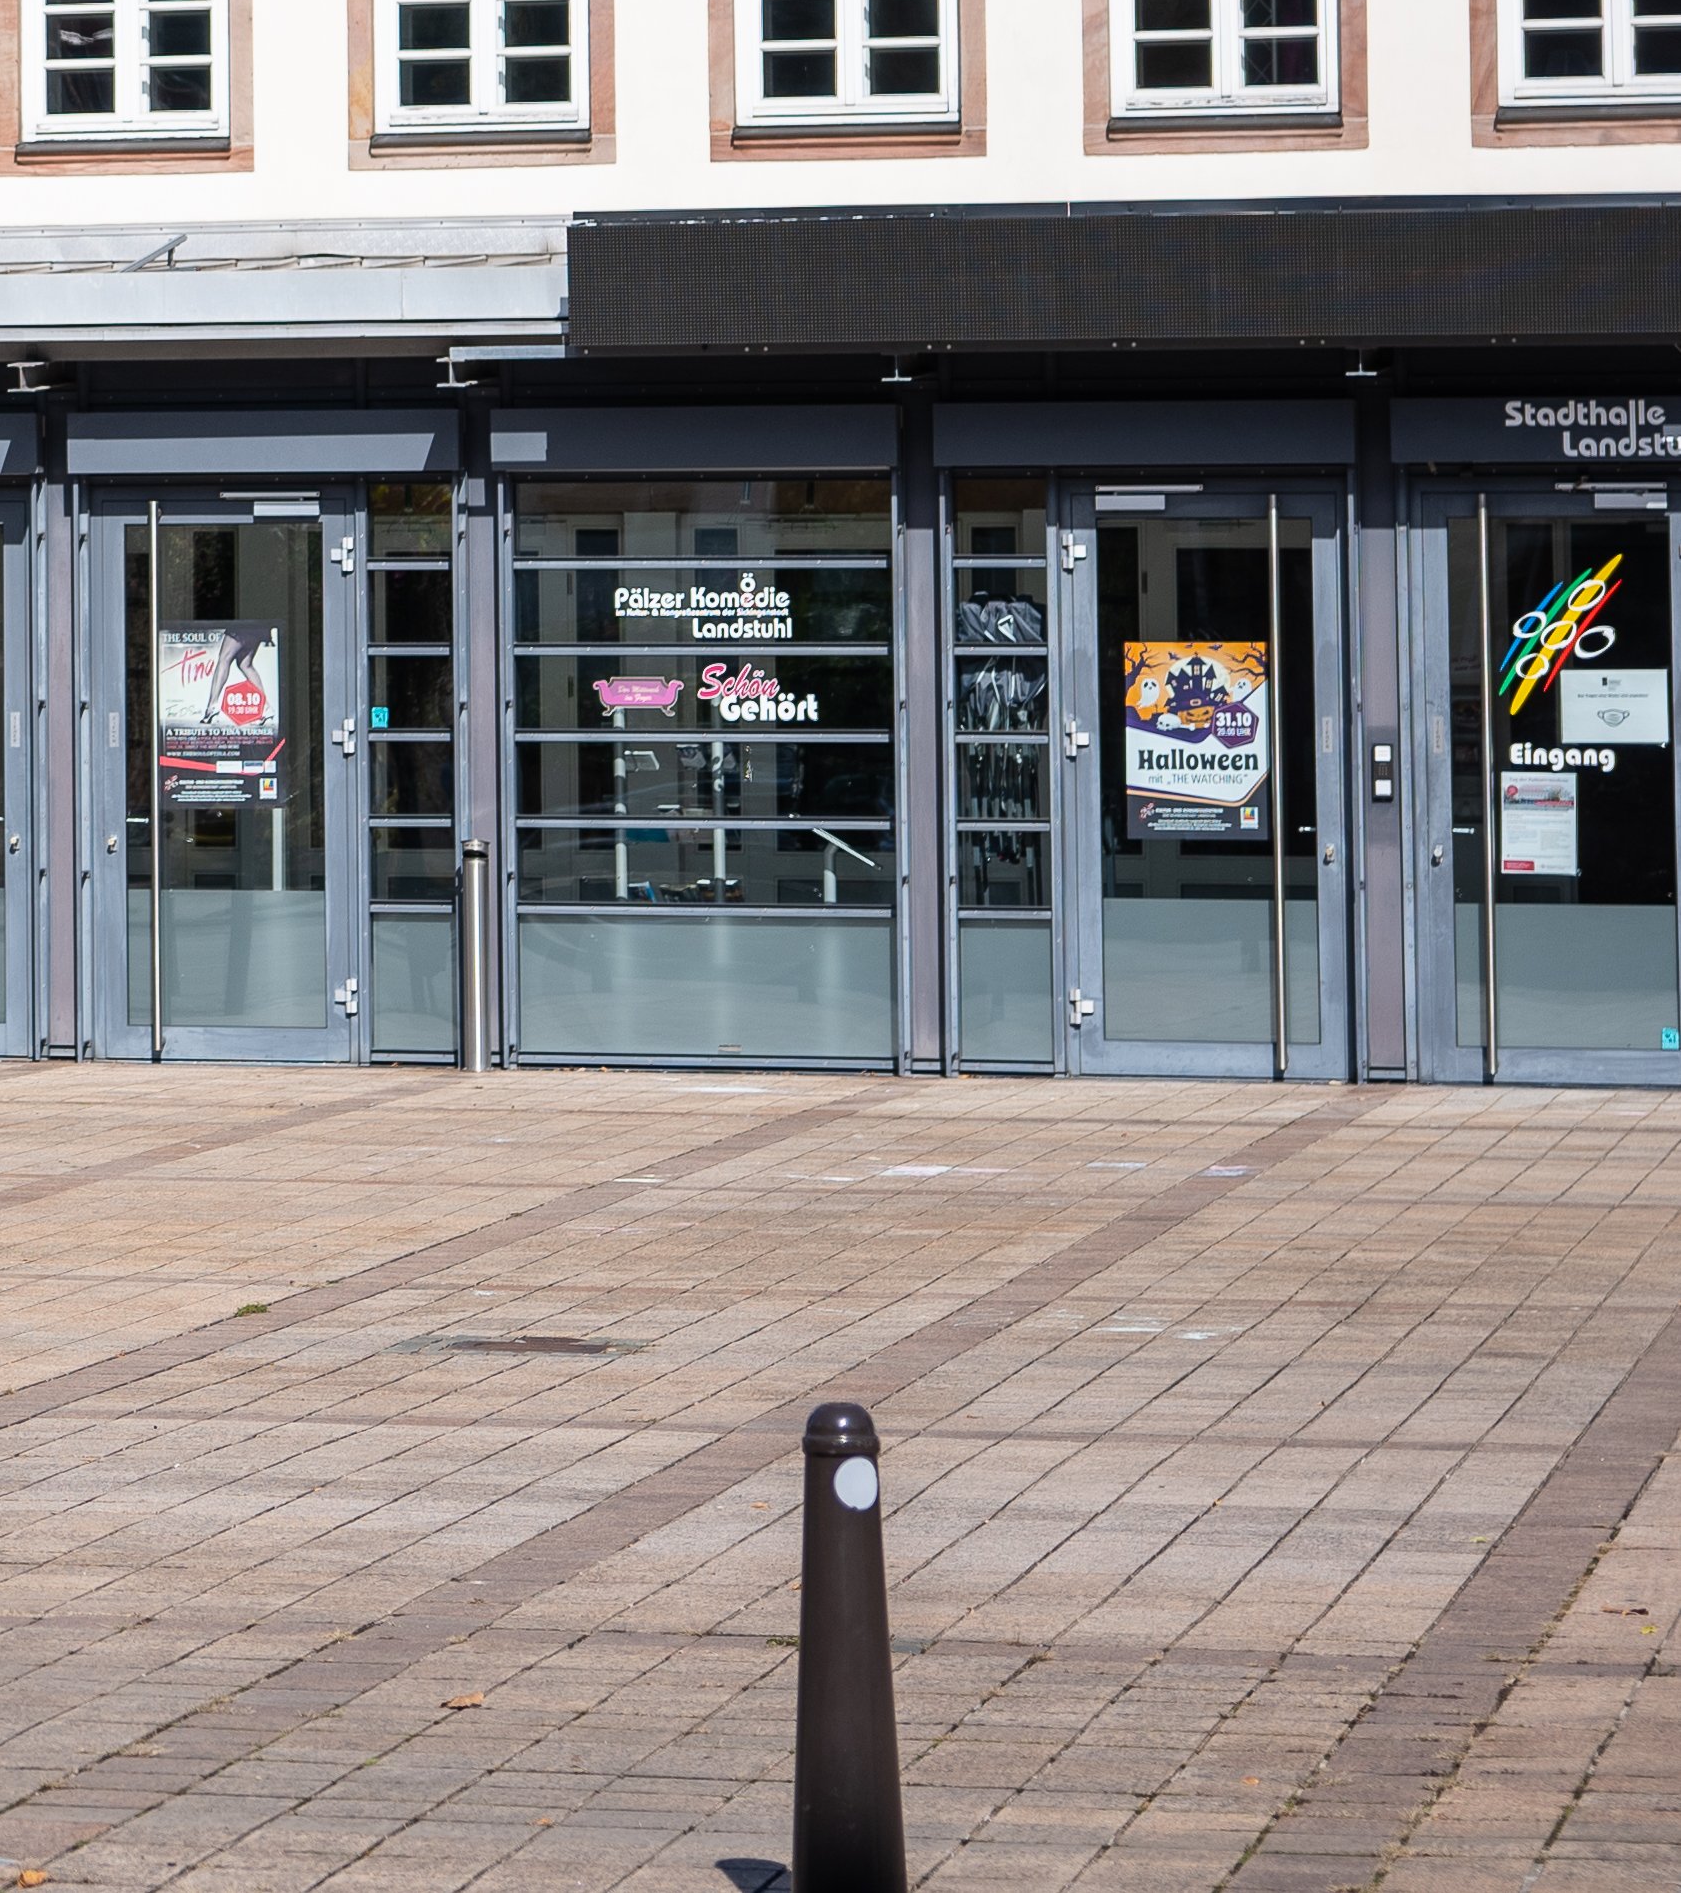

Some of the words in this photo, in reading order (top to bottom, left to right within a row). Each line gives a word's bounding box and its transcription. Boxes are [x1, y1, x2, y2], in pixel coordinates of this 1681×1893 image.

[1505, 400, 1666, 427] Stadthalle
[614, 588, 685, 608] Pälzer
[163, 633, 181, 642] THE
[182, 633, 207, 642] SOUL
[208, 633, 222, 642] OF
[692, 618, 793, 638] Landstuhl
[697, 663, 780, 699] Schön
[226, 693, 261, 705] 08.10
[720, 693, 819, 721] Gehört
[1215, 712, 1252, 727] 31.10
[1138, 749, 1258, 770] Halloween
[1510, 742, 1615, 772] Eingang
[1148, 773, 1163, 784] mit
